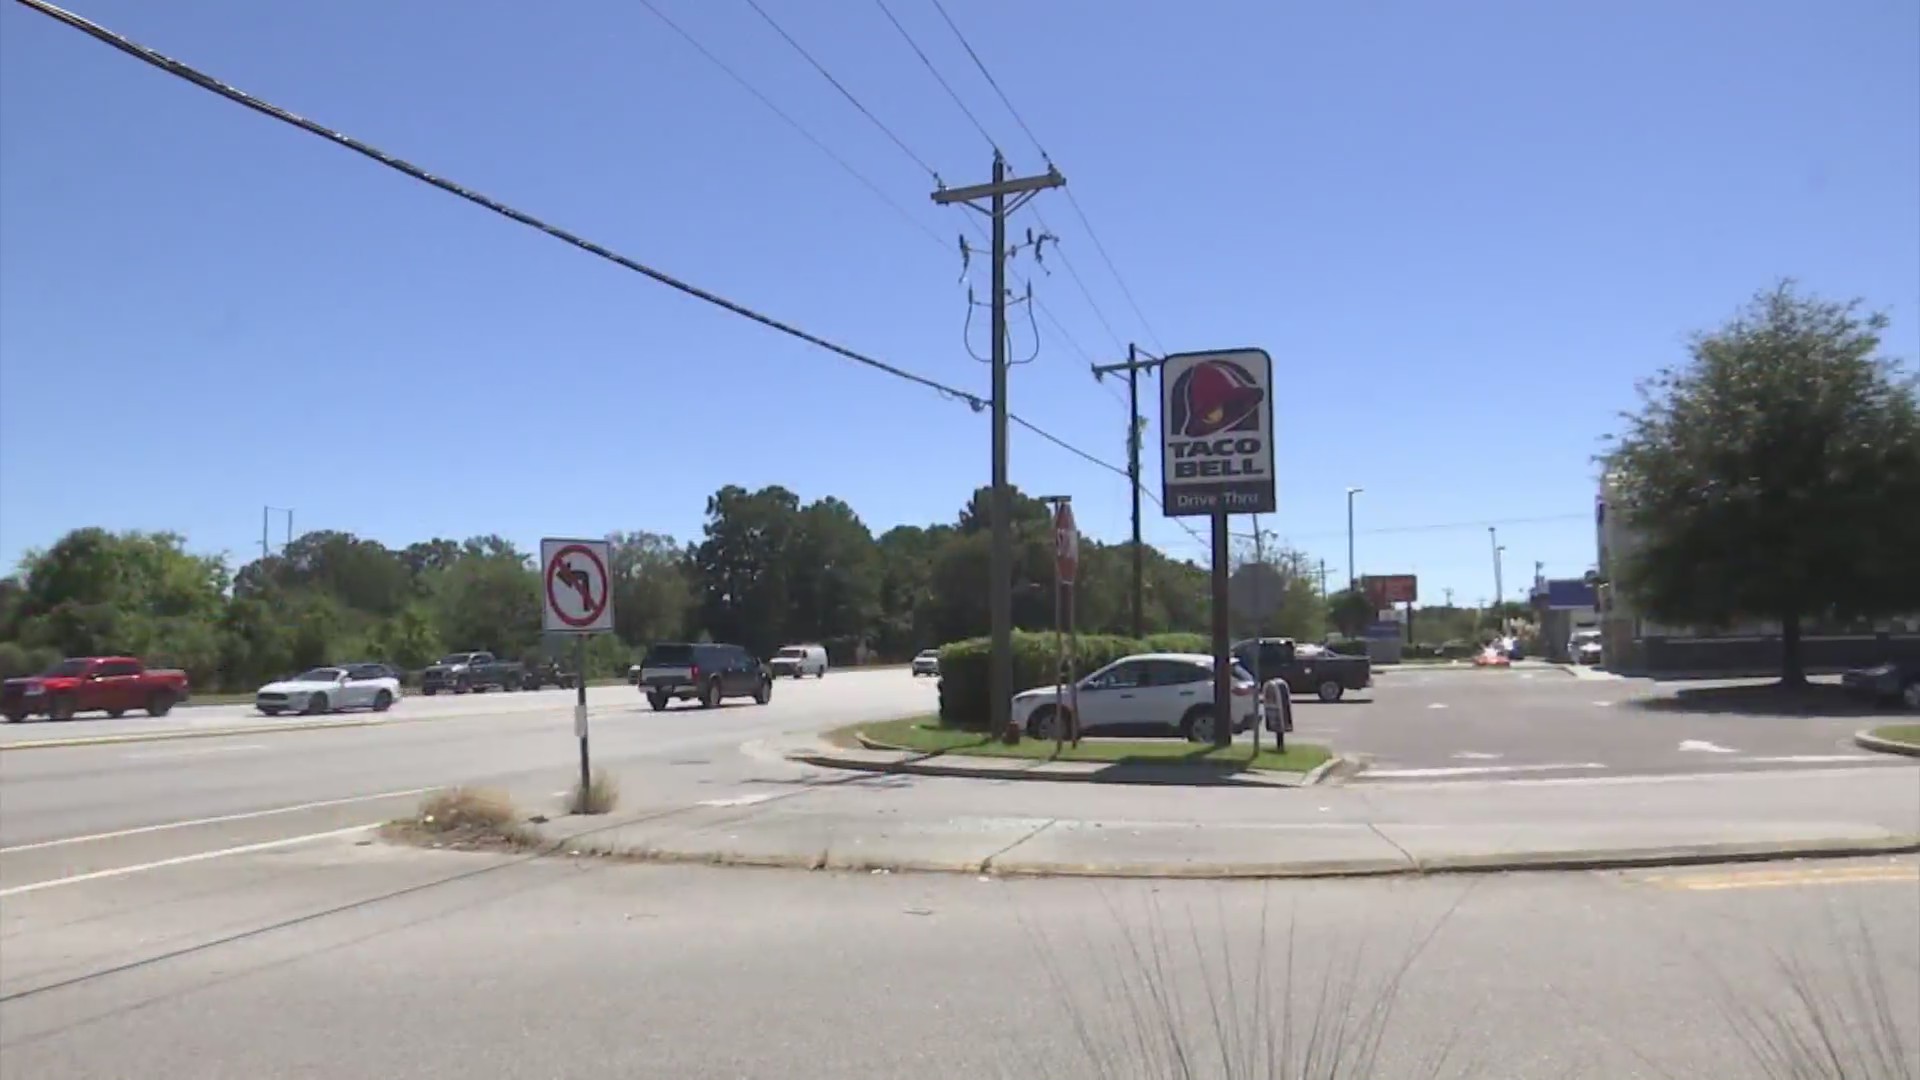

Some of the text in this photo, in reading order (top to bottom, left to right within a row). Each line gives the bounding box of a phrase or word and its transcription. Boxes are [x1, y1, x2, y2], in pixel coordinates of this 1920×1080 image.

[1168, 439, 1261, 458] TACO
[1175, 459, 1263, 478] BELL
[1177, 491, 1259, 507] Drive Thru
